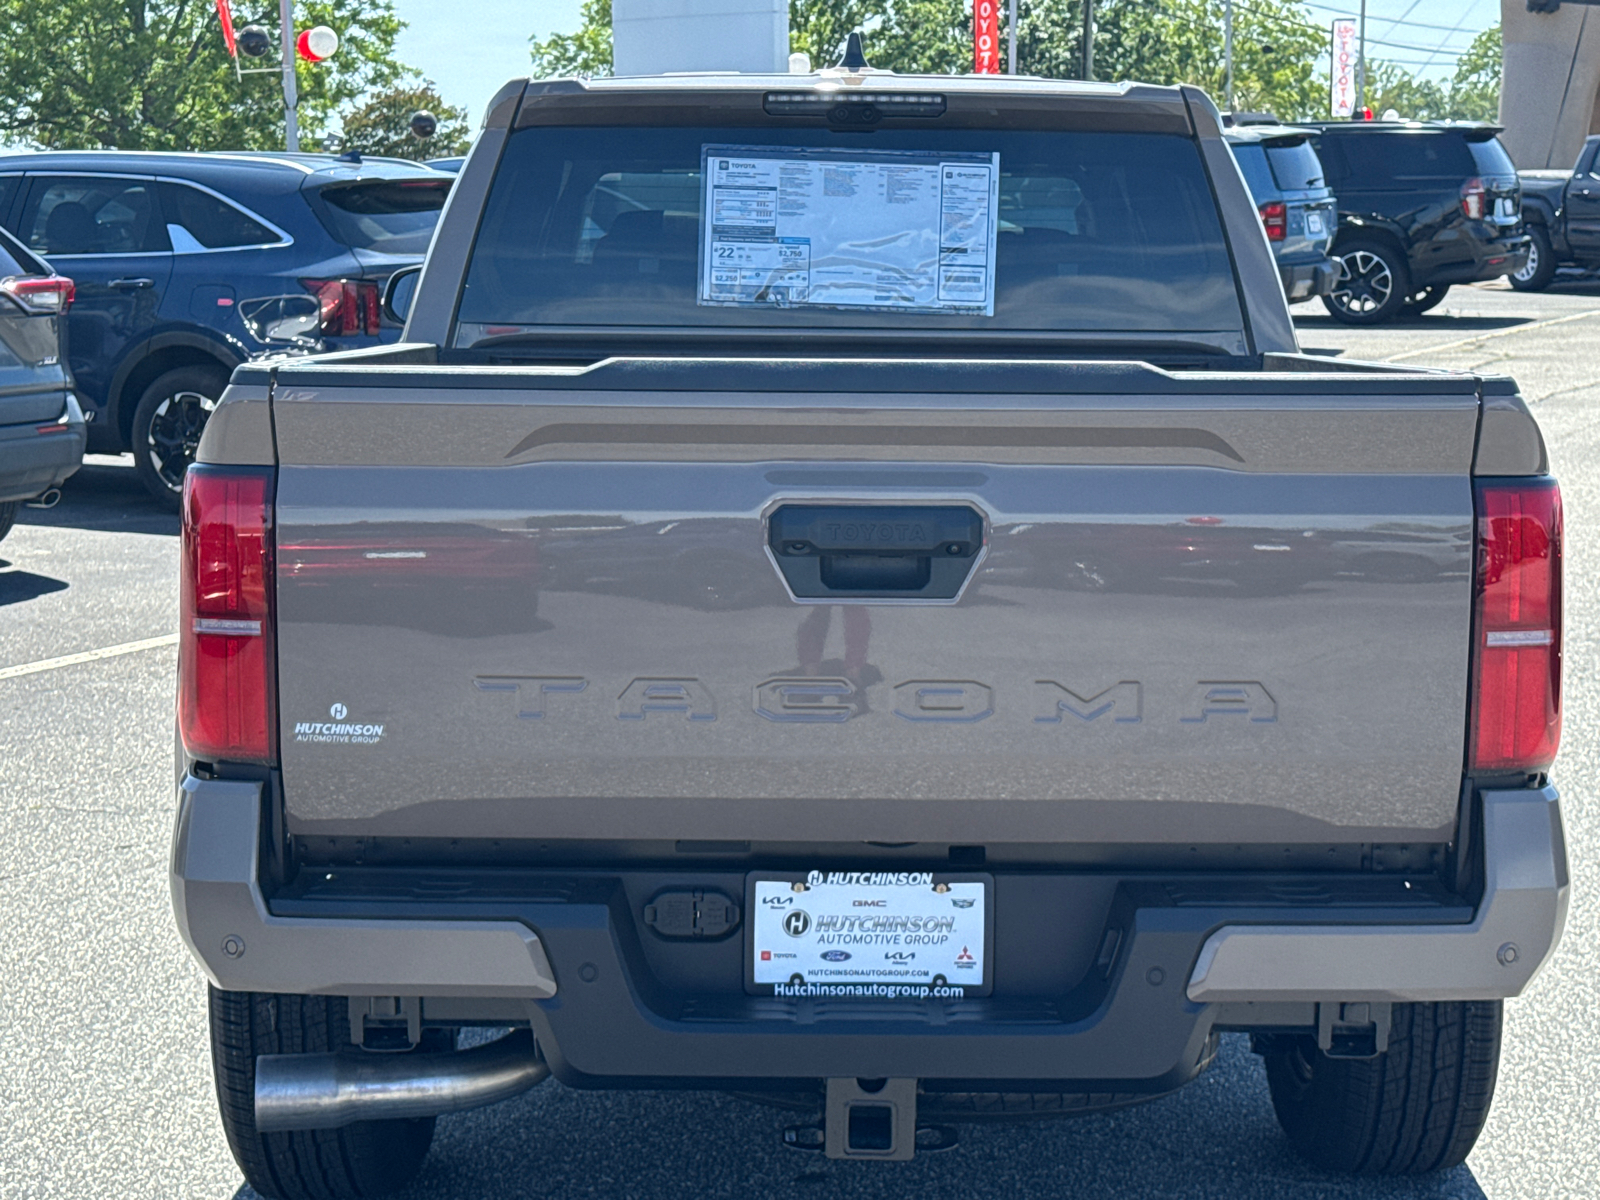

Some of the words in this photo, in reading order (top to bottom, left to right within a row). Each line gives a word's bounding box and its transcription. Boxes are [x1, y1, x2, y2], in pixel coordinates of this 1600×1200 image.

[1338, 41, 1349, 109] TOYOTA
[718, 247, 734, 259] 22
[826, 523, 927, 542] TOYOTA
[472, 674, 1279, 723] TACOMA
[295, 722, 384, 735] HUTCHINSON
[296, 734, 349, 743] AUTOMOTIVE
[351, 735, 380, 744] GROUP
[826, 872, 933, 886] HUTCHINSON
[852, 900, 887, 908] GMC
[815, 915, 956, 933] HUTCHINSON
[817, 933, 901, 945] AUTOMOTIVE
[904, 934, 949, 946] GROUP
[807, 969, 930, 977] HUTCHINSONAUTOGROUP.COM
[774, 983, 964, 1000] Hutchinsonautogroup.com
